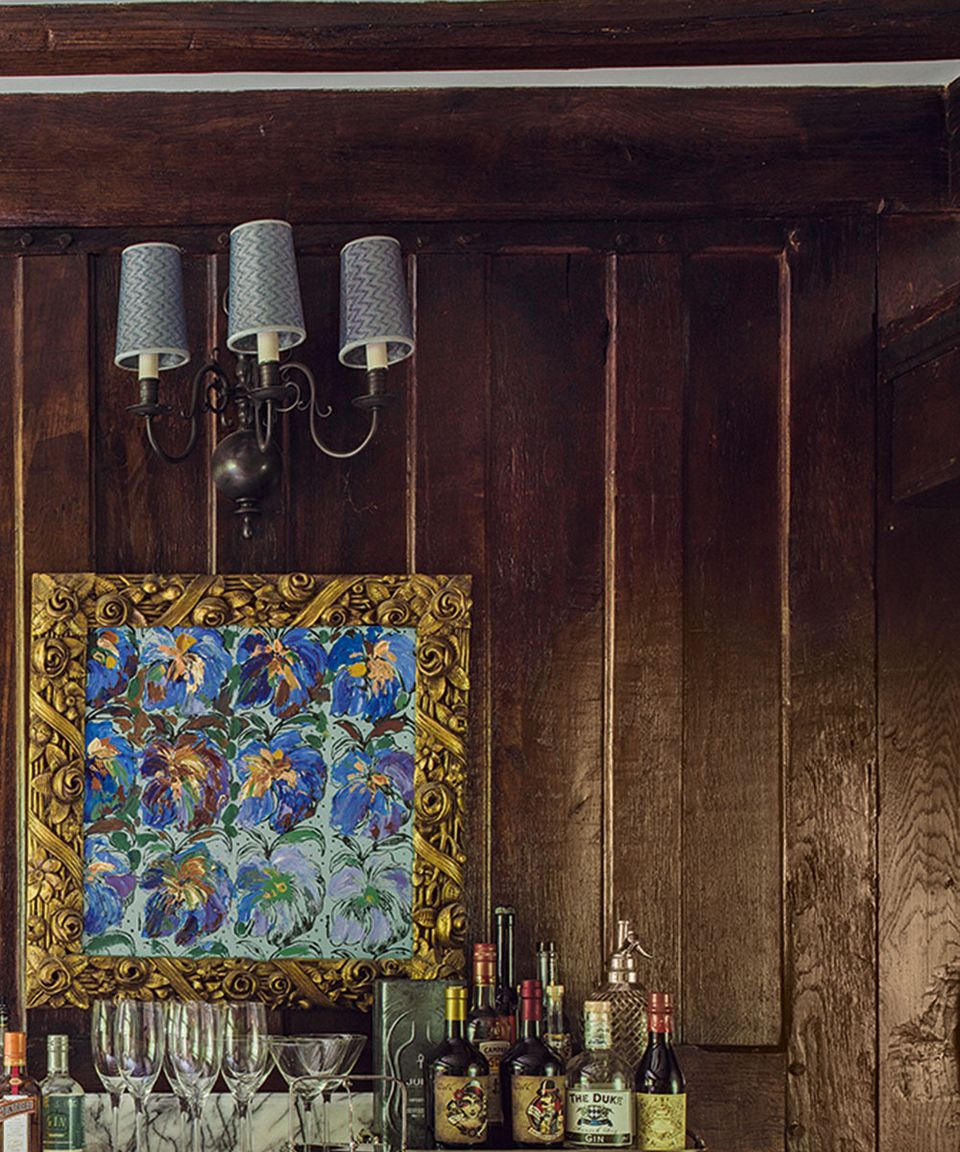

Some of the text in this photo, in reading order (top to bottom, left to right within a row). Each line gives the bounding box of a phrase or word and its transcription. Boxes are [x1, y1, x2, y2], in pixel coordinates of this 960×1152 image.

[569, 1093, 623, 1105] THE DUKE
[585, 1134, 605, 1143] GIN
